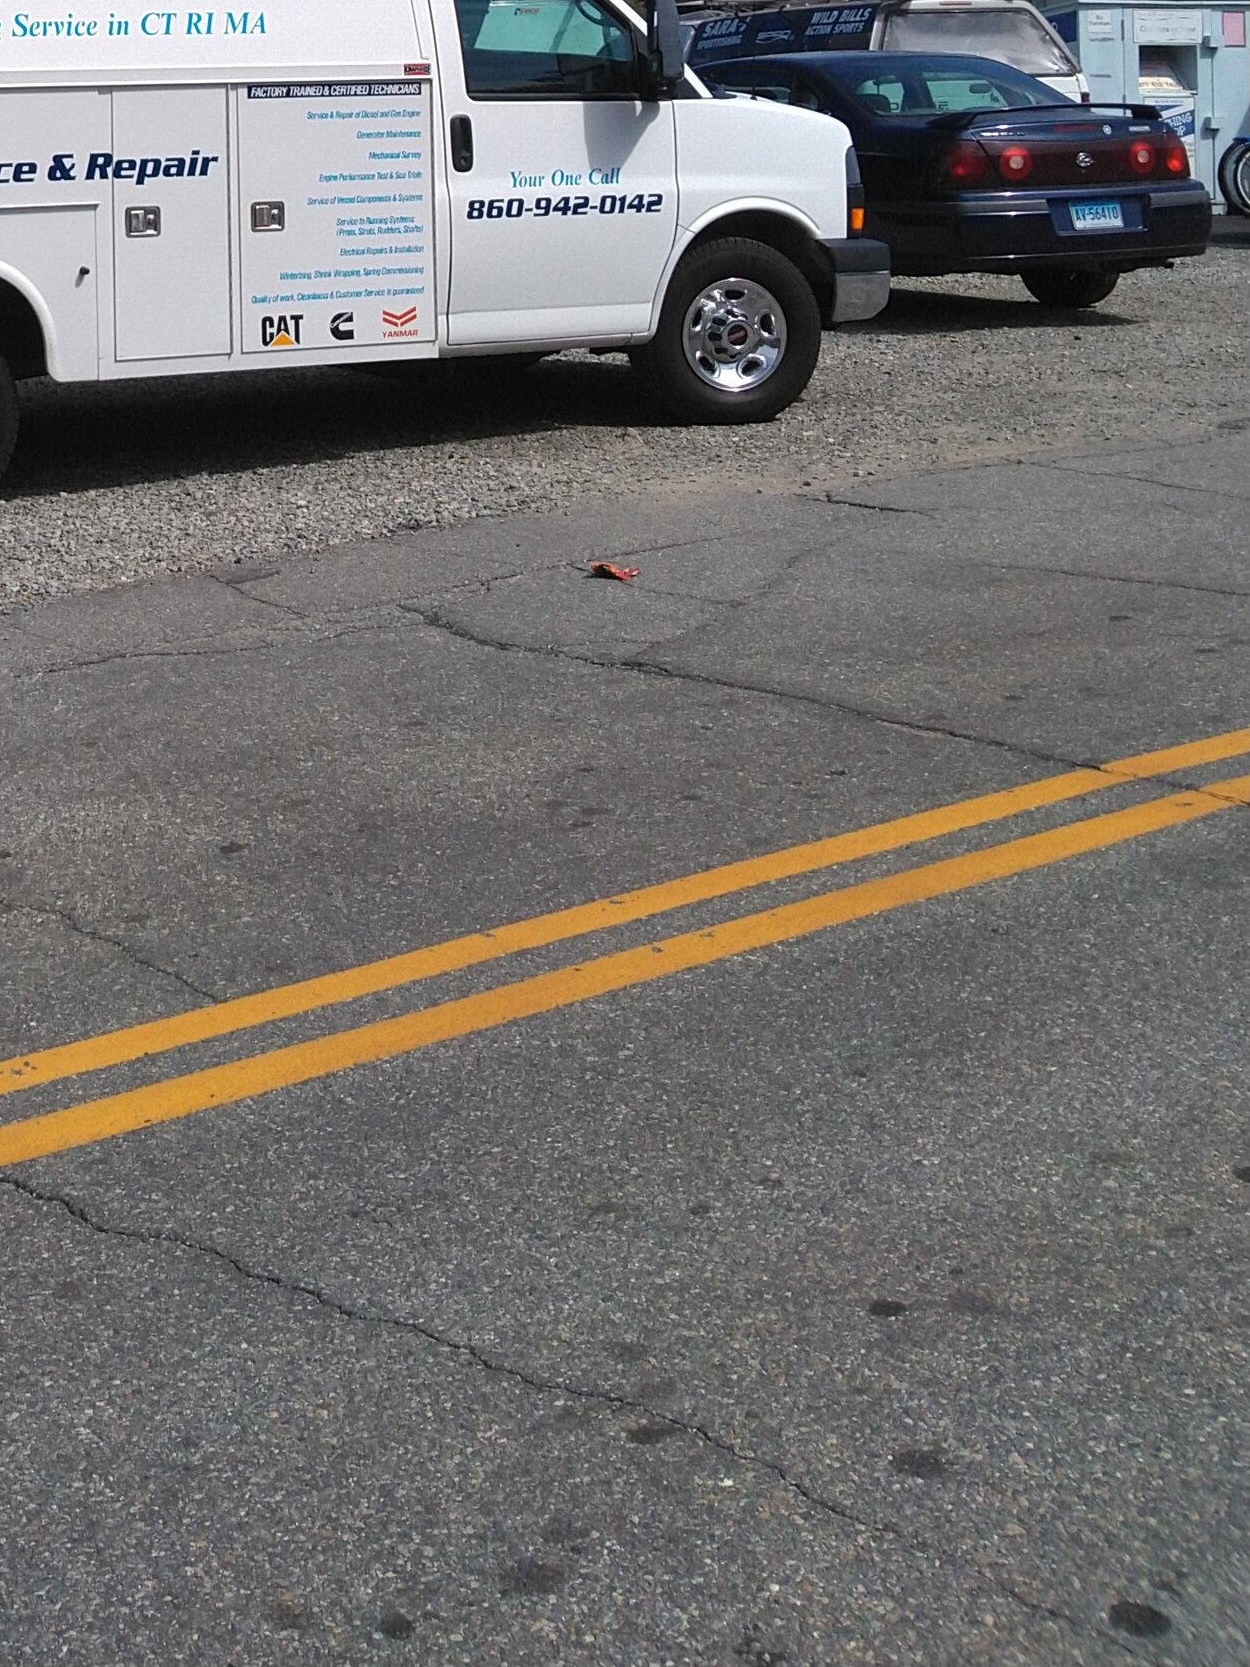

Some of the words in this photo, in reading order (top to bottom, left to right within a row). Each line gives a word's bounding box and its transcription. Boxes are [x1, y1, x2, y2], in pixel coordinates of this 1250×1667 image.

[12, 13, 98, 37] Service
[108, 13, 129, 35] in
[141, 12, 177, 35] CT
[185, 12, 214, 34] RI
[224, 12, 267, 34] MA
[810, 10, 838, 25] WILD
[838, 8, 873, 23] BILLS
[804, 24, 832, 36] ACTION
[832, 22, 865, 34] SPORTS
[250, 86, 287, 98] FACTORY
[289, 85, 323, 96] TRAINED
[323, 85, 330, 96] &
[330, 84, 368, 95] CERTIFIED
[370, 83, 420, 95] TECHNICIANS
[47, 153, 77, 181] &
[84, 150, 219, 185] Repair
[510, 170, 545, 189] Your
[551, 168, 582, 187] One
[588, 167, 620, 185] Call
[467, 193, 664, 220] 860-942-0142
[261, 314, 304, 347] CAT
[382, 329, 419, 339] YANMAR
